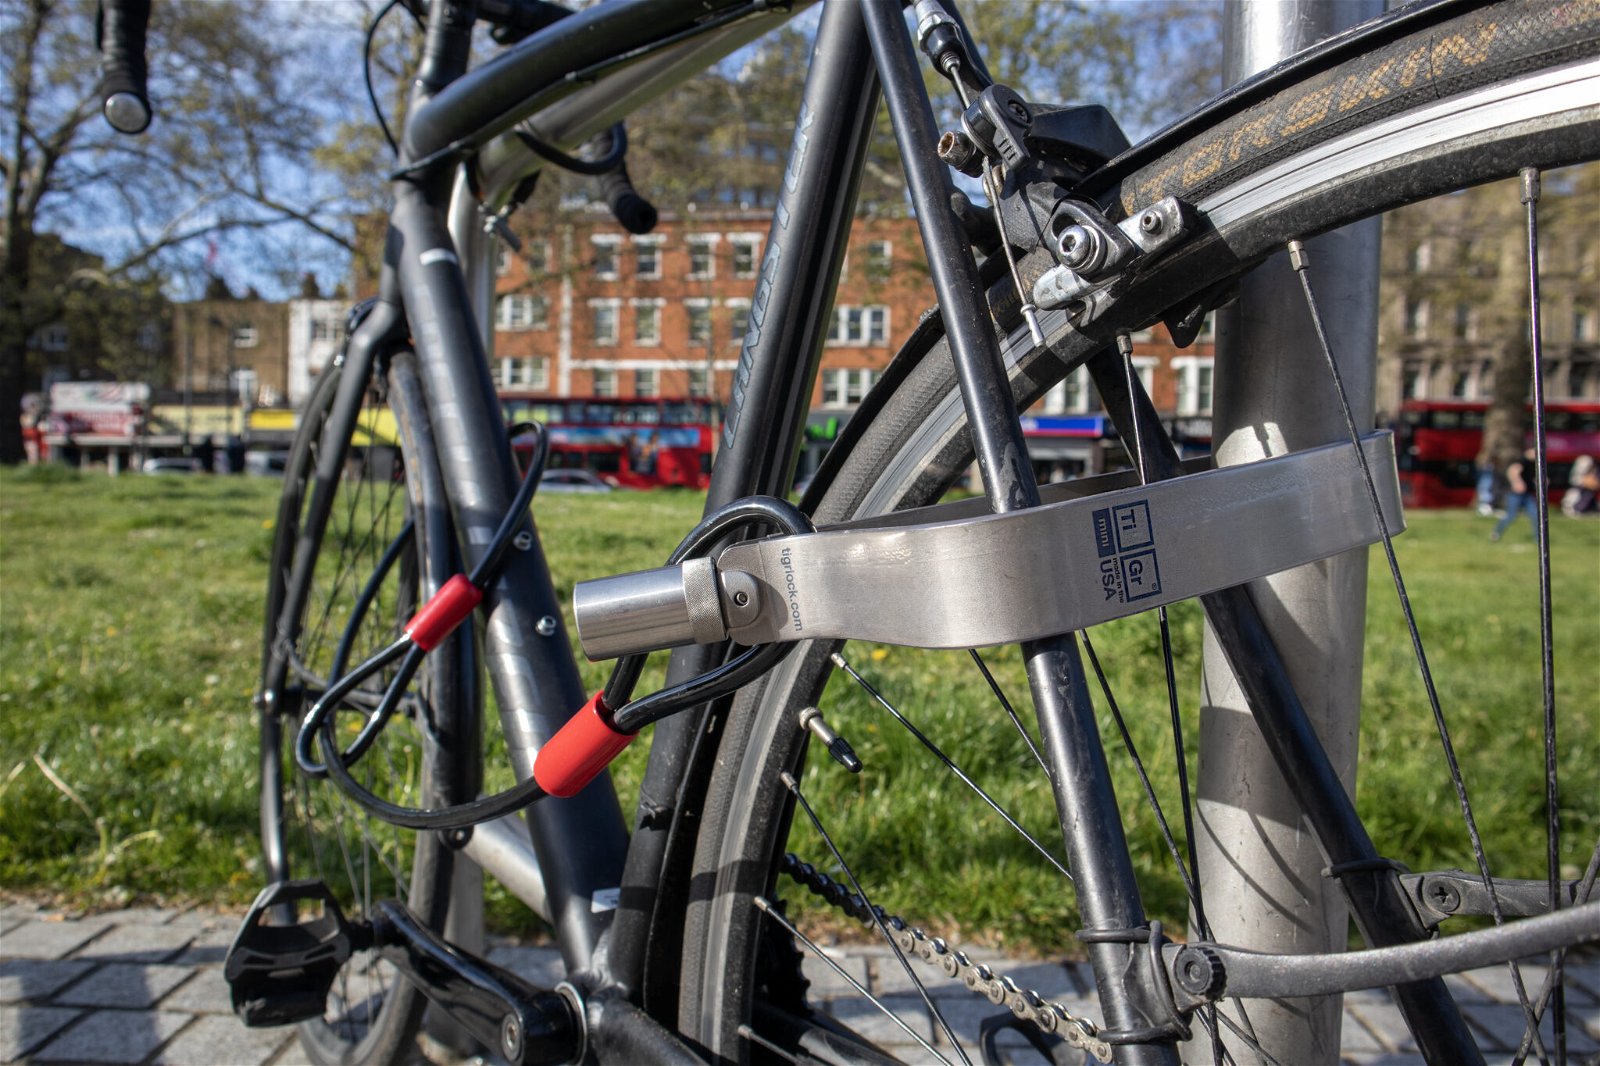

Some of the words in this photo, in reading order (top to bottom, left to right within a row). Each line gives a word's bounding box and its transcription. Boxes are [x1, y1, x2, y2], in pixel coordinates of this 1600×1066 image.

[1098, 516, 1110, 547] mini
[1100, 559, 1116, 601] USA
[1112, 557, 1121, 580] made
[780, 547, 803, 632] tigrlock.com
